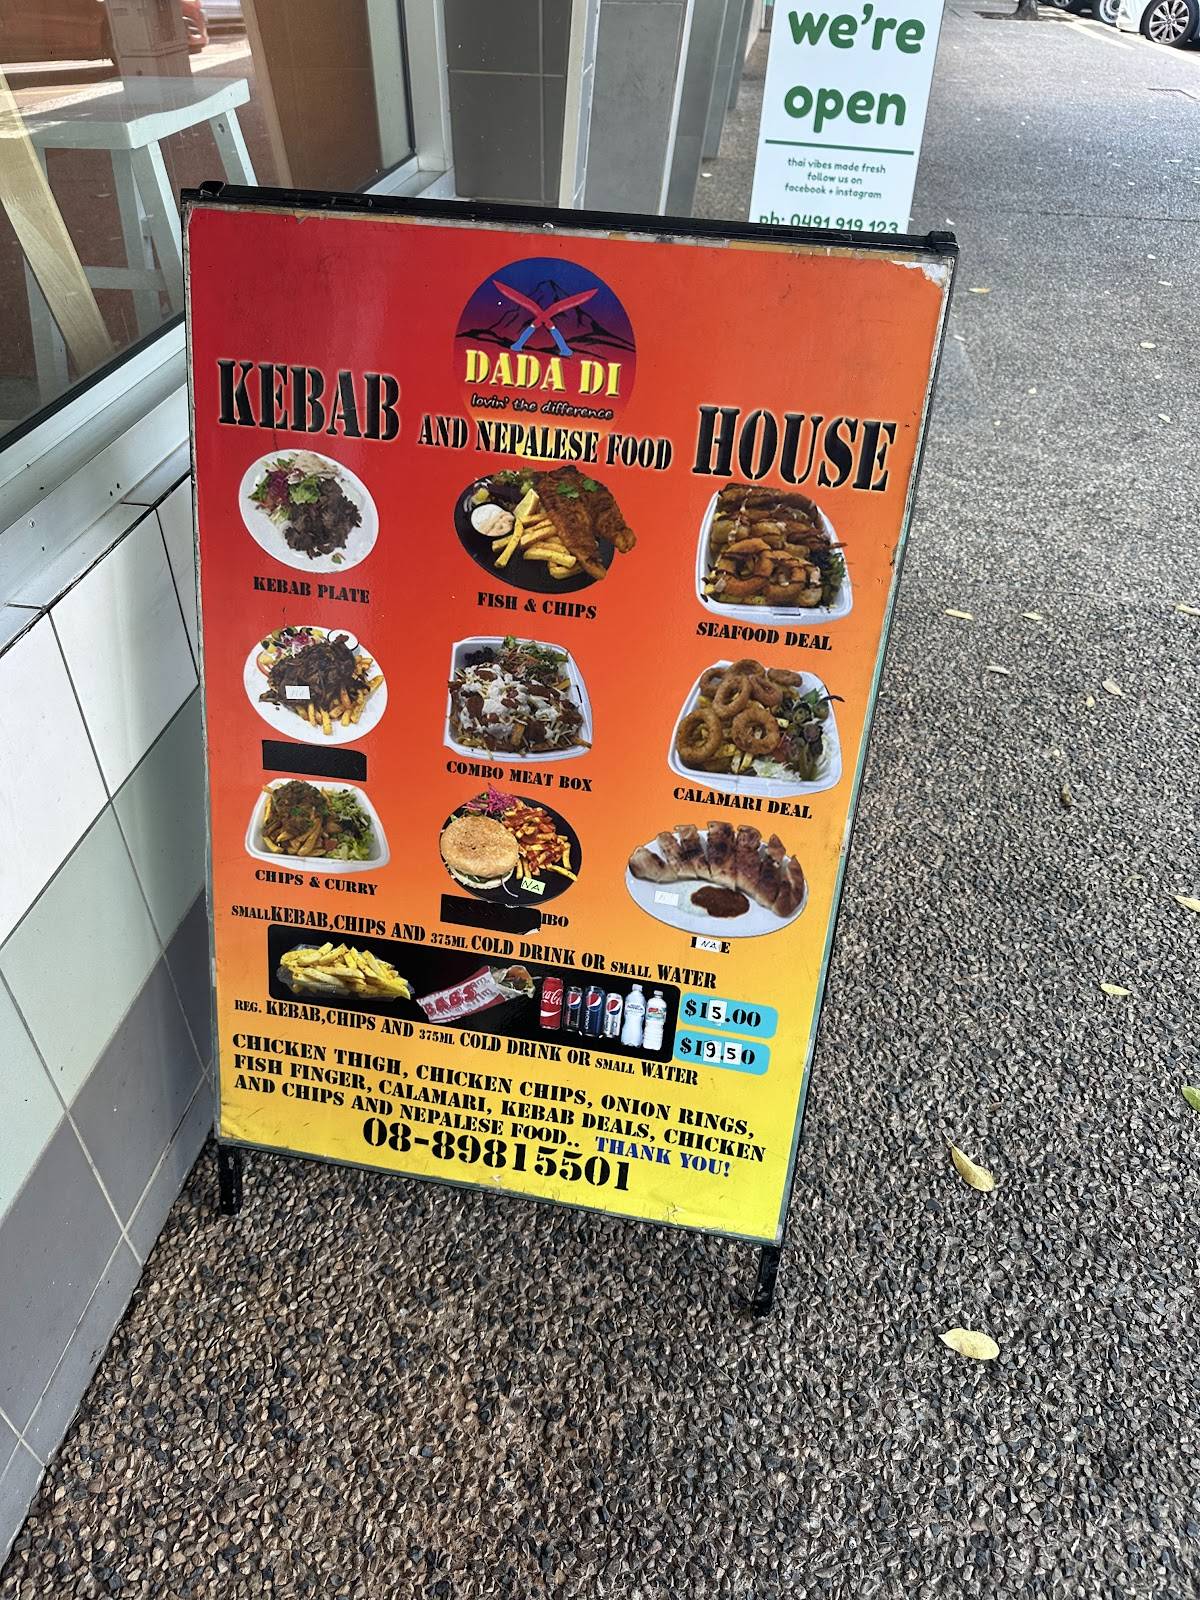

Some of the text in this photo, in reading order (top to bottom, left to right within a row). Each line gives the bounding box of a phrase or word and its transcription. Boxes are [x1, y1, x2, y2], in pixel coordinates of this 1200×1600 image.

[788, 4, 926, 54] we're
[784, 85, 906, 133] open
[787, 157, 886, 174] thai vibes made fresh
[807, 172, 836, 183] follow
[838, 176, 849, 184] us
[784, 183, 826, 195] facebook
[835, 187, 882, 199] instagram
[465, 349, 622, 397] DADA DI
[217, 359, 401, 442] KEBAB
[471, 394, 614, 420] lovin' the difference
[417, 414, 674, 471] AND NEPALESE FOOD
[692, 406, 897, 493] HOUSE
[253, 576, 370, 604] KEBAB PLATE
[477, 592, 597, 620] FISH & CHIPS
[696, 621, 833, 651] SEAFOOD DEAL
[446, 760, 593, 792] COMBO MEAT BOX
[673, 787, 812, 819] CALAMARI DEAL
[255, 869, 378, 896] CHIPS & CURRY
[391, 922, 426, 943] AND
[430, 932, 468, 950] 375ML
[471, 934, 513, 957] COLD
[519, 941, 576, 967] DRINK
[581, 951, 605, 972] OR
[610, 961, 651, 979] SMALL
[658, 964, 717, 990] WATER
[684, 998, 762, 1028] $15.00
[234, 999, 262, 1014] REG.
[381, 1024, 414, 1038] AND
[419, 1029, 455, 1046] 375ML
[460, 1031, 501, 1053] COLD
[506, 1038, 562, 1063] DRINK
[567, 1048, 591, 1068] OR
[595, 1057, 635, 1075] SMALL
[641, 1061, 699, 1087] WATER
[680, 1037, 756, 1065] $19.50
[232, 1033, 755, 1139] CHICKEN THIGH, CHICKEN CHIPS, ONION RINGS,
[233, 1053, 767, 1163] FISH FINGER, CALAMARI, KEBAB DEALS, CHICKEN
[234, 1074, 276, 1094] AND
[281, 1081, 345, 1106] CHIPS
[351, 1095, 393, 1116] AND
[399, 1104, 504, 1135] NEPALESE
[595, 1136, 671, 1165] THANK
[679, 1152, 731, 1178] YOU!
[362, 1117, 631, 1191] 08-89815501
